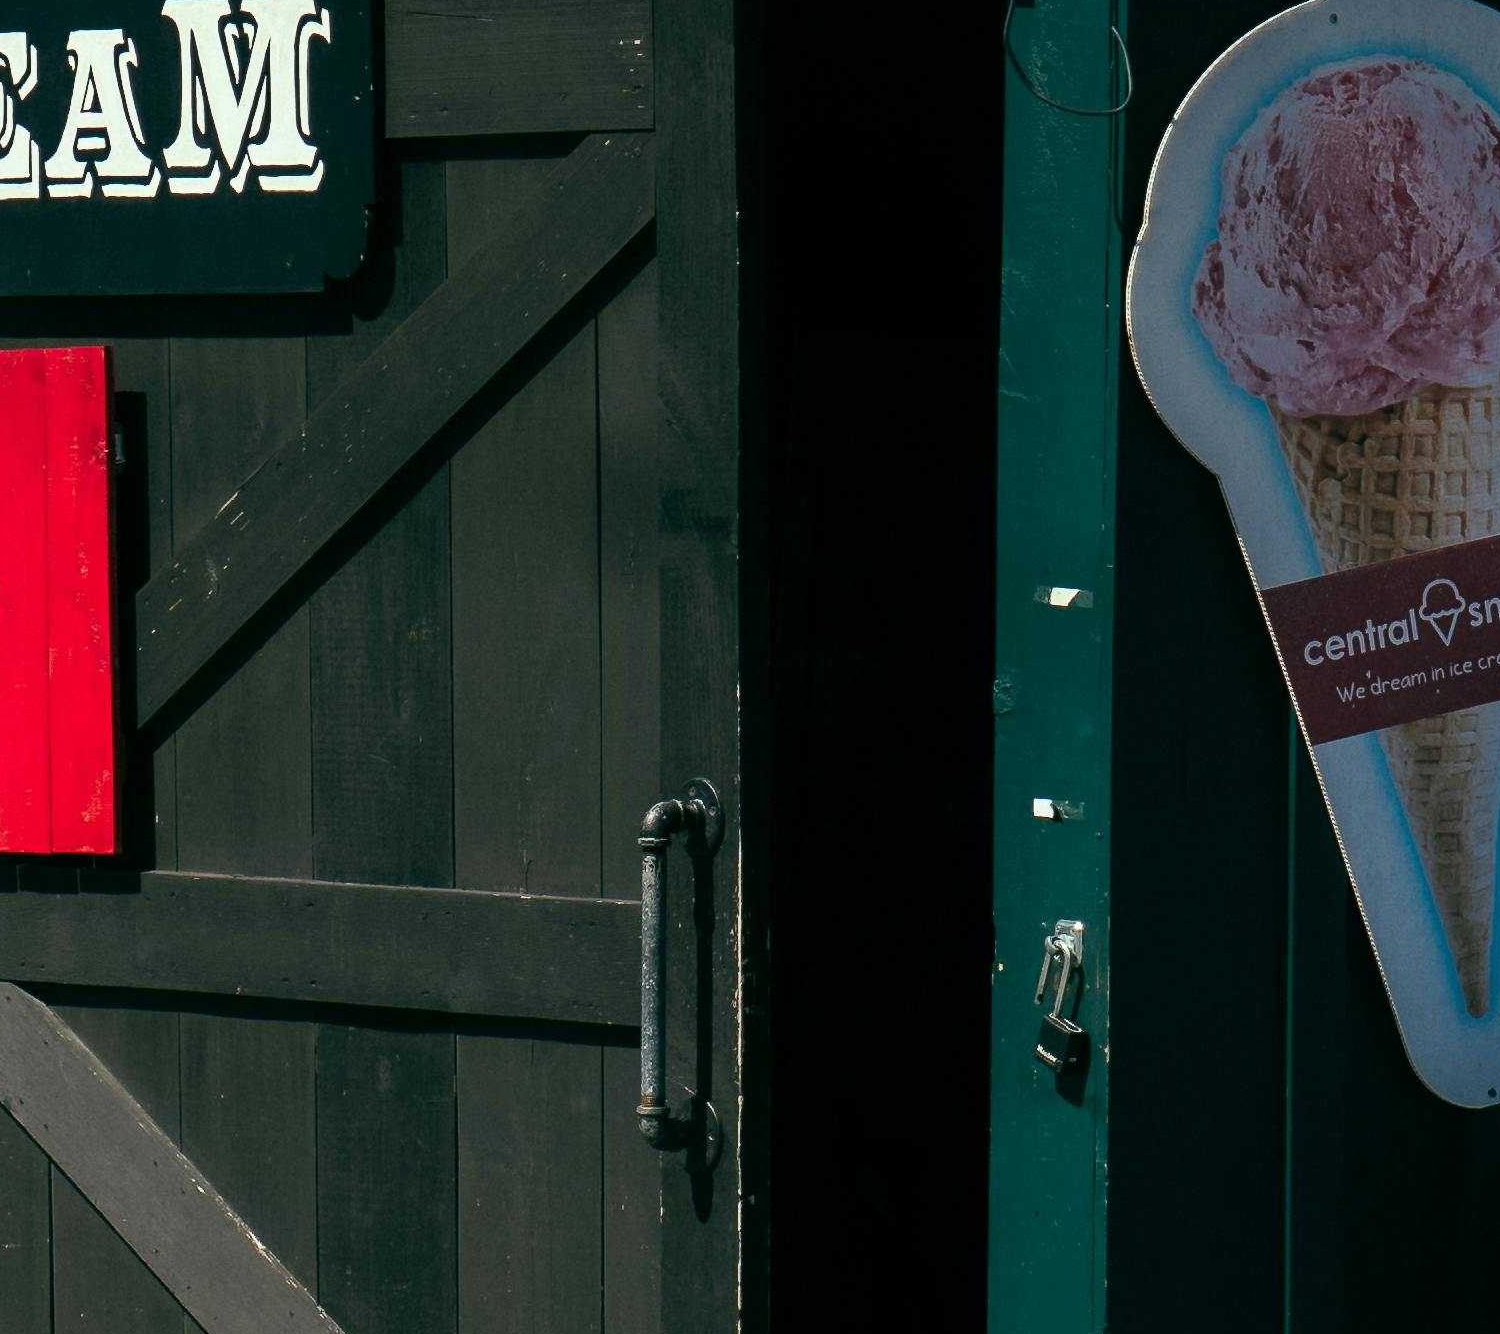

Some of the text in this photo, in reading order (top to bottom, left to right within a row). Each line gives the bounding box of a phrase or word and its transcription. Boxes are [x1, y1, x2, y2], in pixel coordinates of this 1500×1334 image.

[1303, 608, 1420, 666] central
[1336, 682, 1366, 704] We
[1370, 670, 1427, 696] dream
[1431, 666, 1445, 682] in
[1449, 660, 1473, 677] ice
